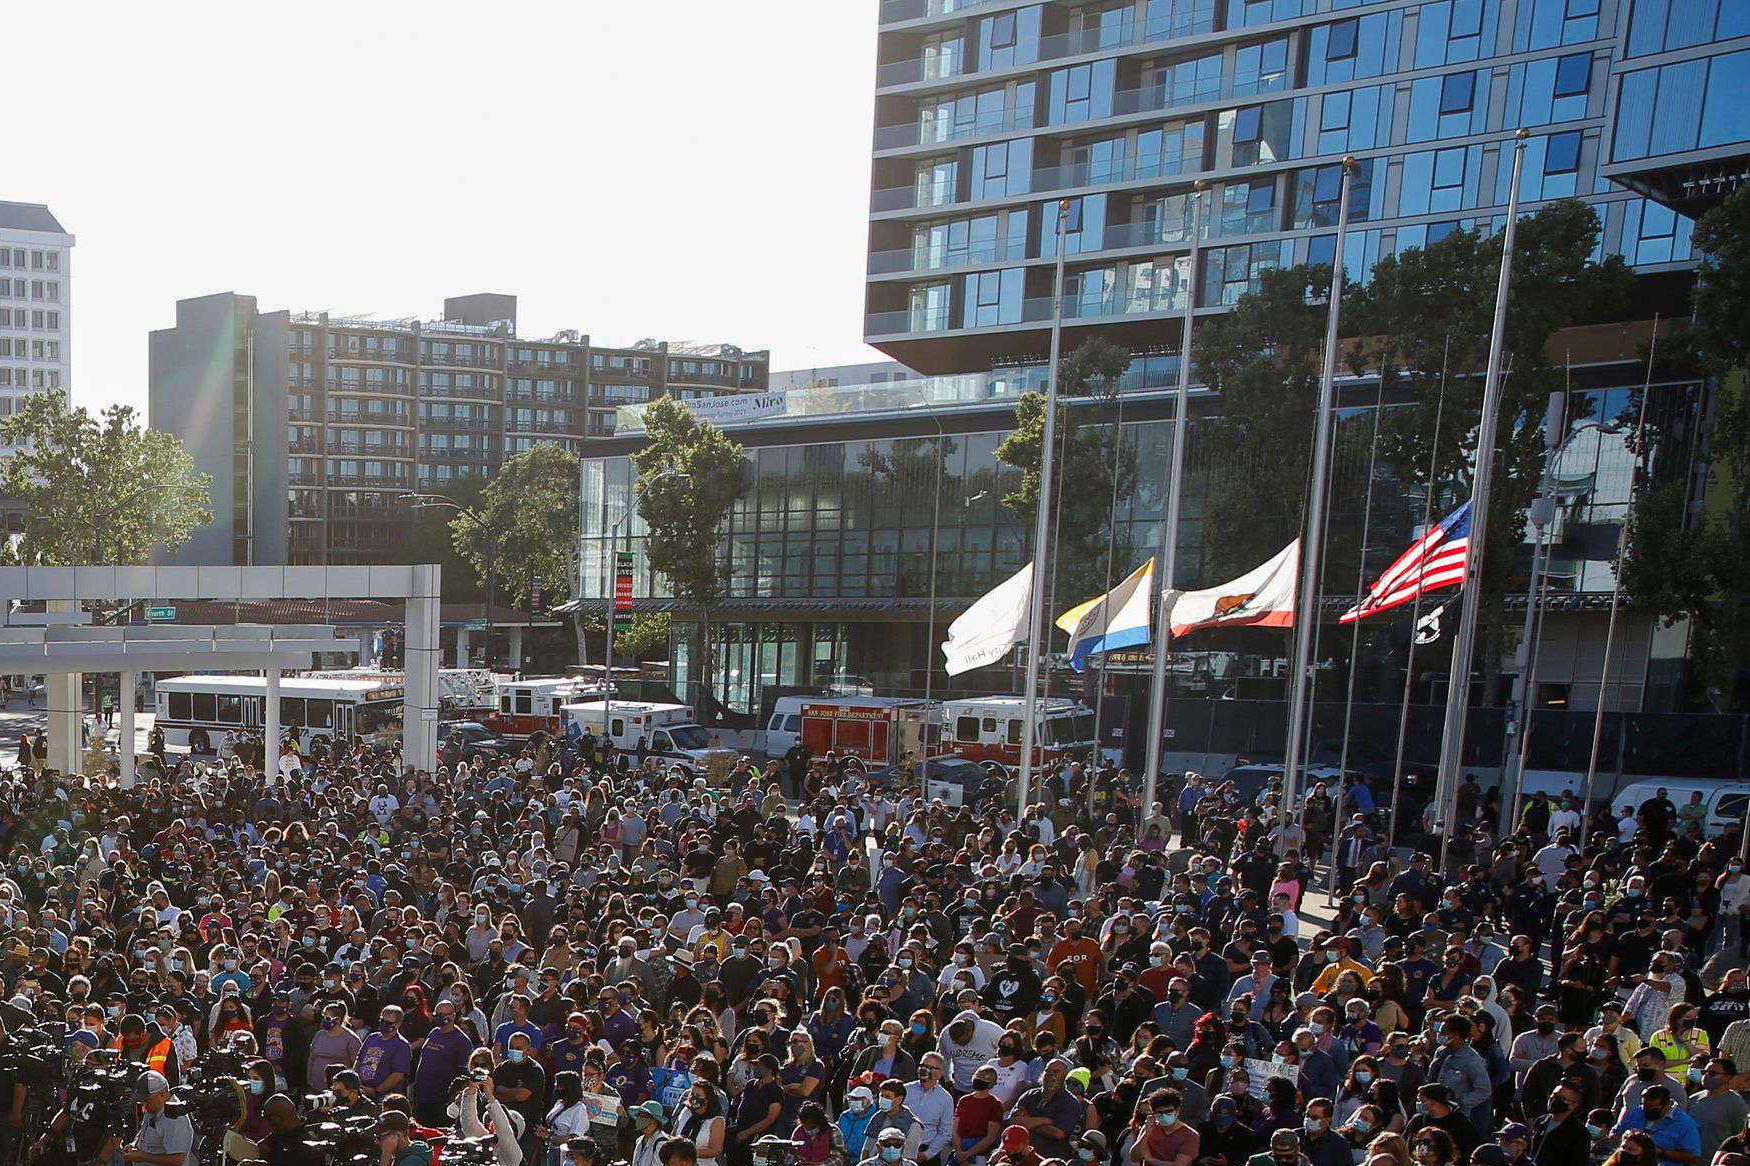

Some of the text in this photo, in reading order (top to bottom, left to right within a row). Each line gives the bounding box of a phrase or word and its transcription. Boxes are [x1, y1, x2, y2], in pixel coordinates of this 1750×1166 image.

[753, 397, 783, 411] Miro
[848, 711, 884, 720] DEPARTMENT
[1066, 954, 1088, 962] FOR
